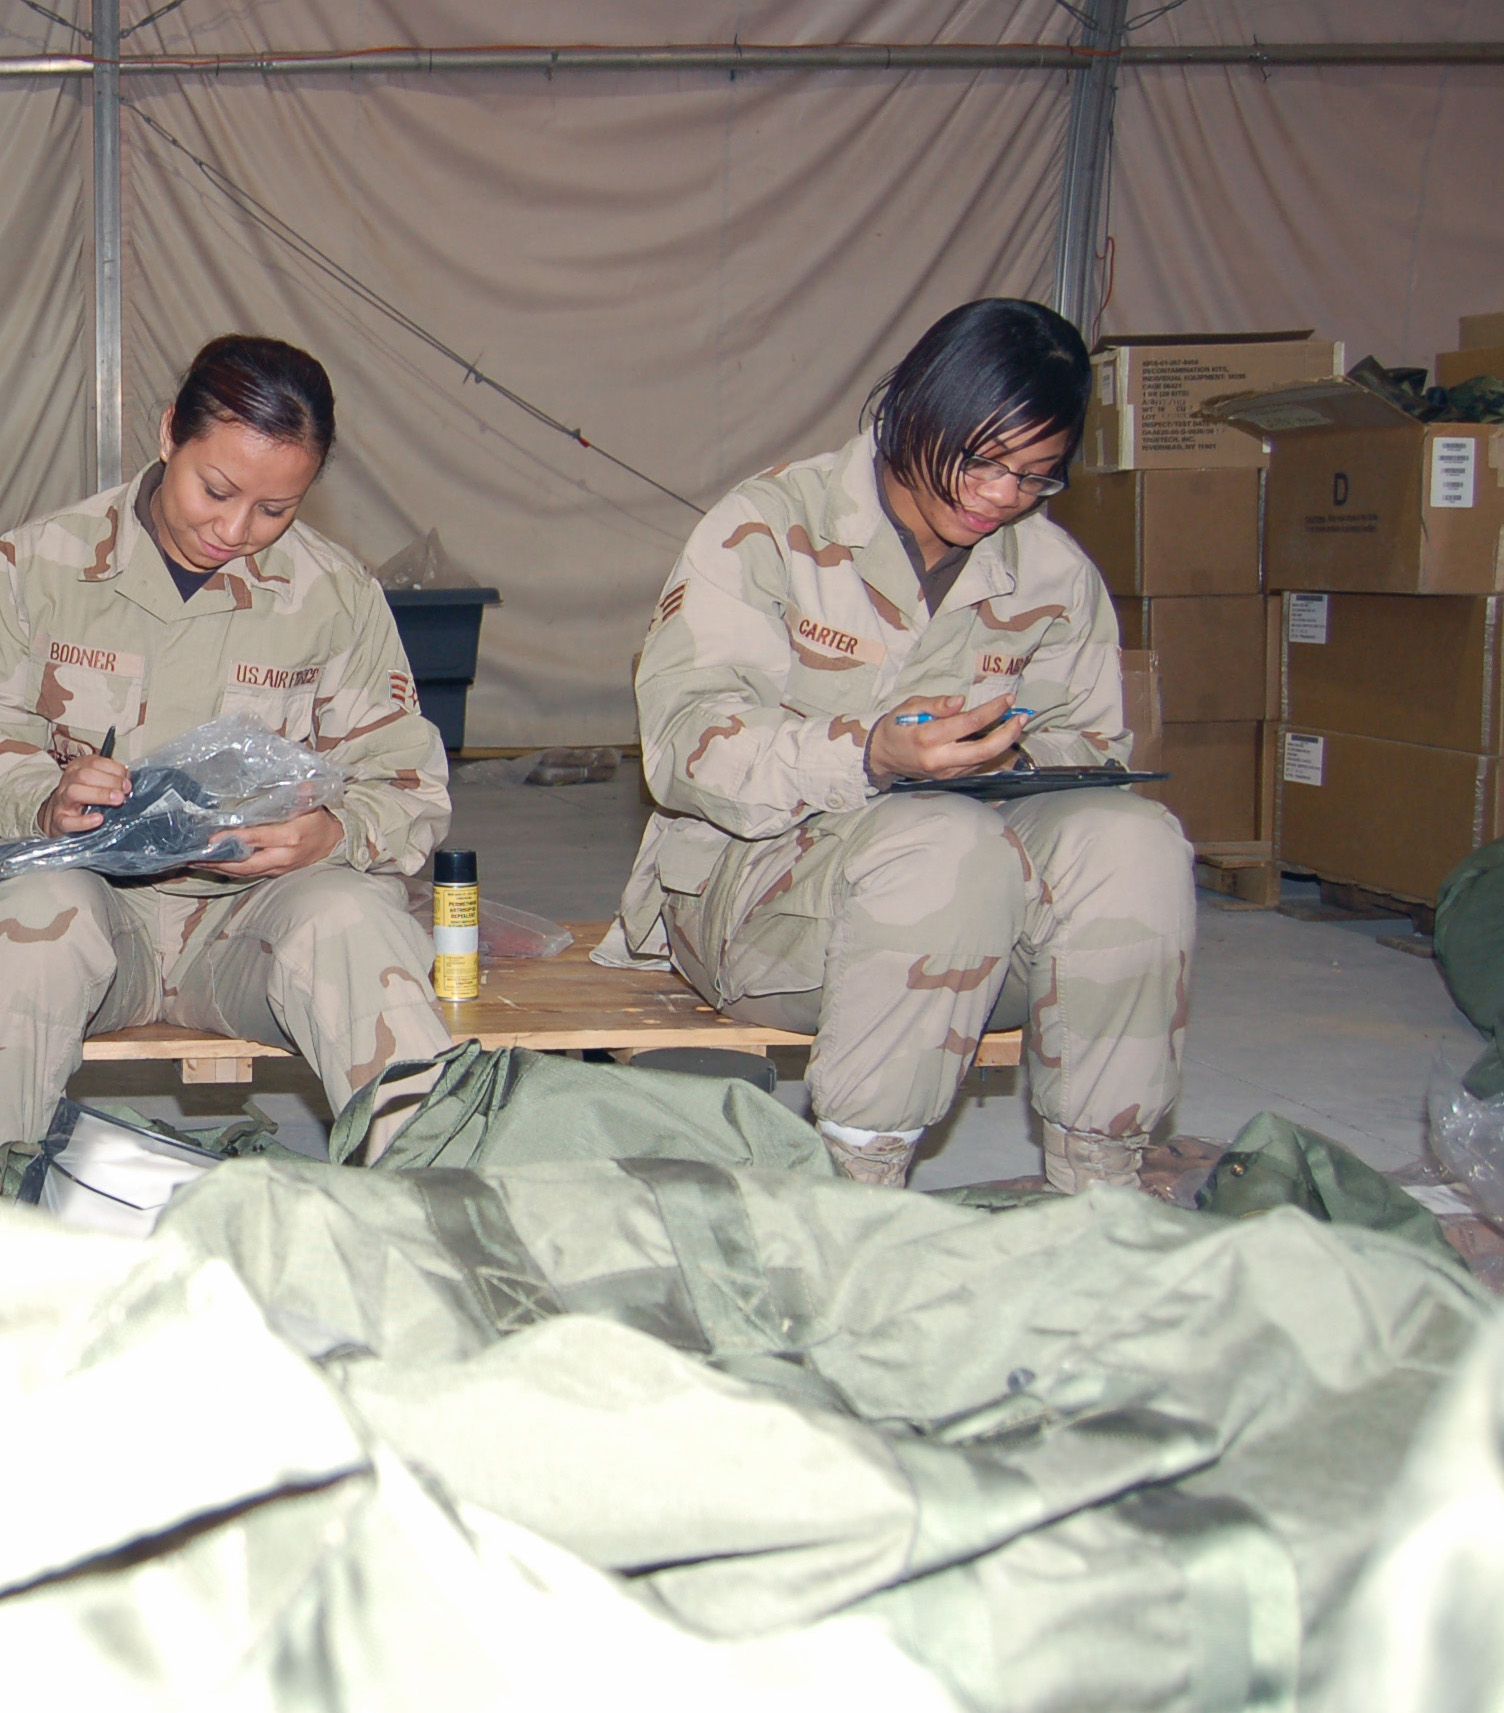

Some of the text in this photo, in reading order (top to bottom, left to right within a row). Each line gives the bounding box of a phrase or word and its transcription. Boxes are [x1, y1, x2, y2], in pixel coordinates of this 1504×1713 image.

[1332, 471, 1350, 506] D
[799, 619, 858, 654] CARTER
[50, 642, 116, 672] BODNER
[982, 654, 1003, 674] U.S.
[262, 668, 288, 688] AIR
